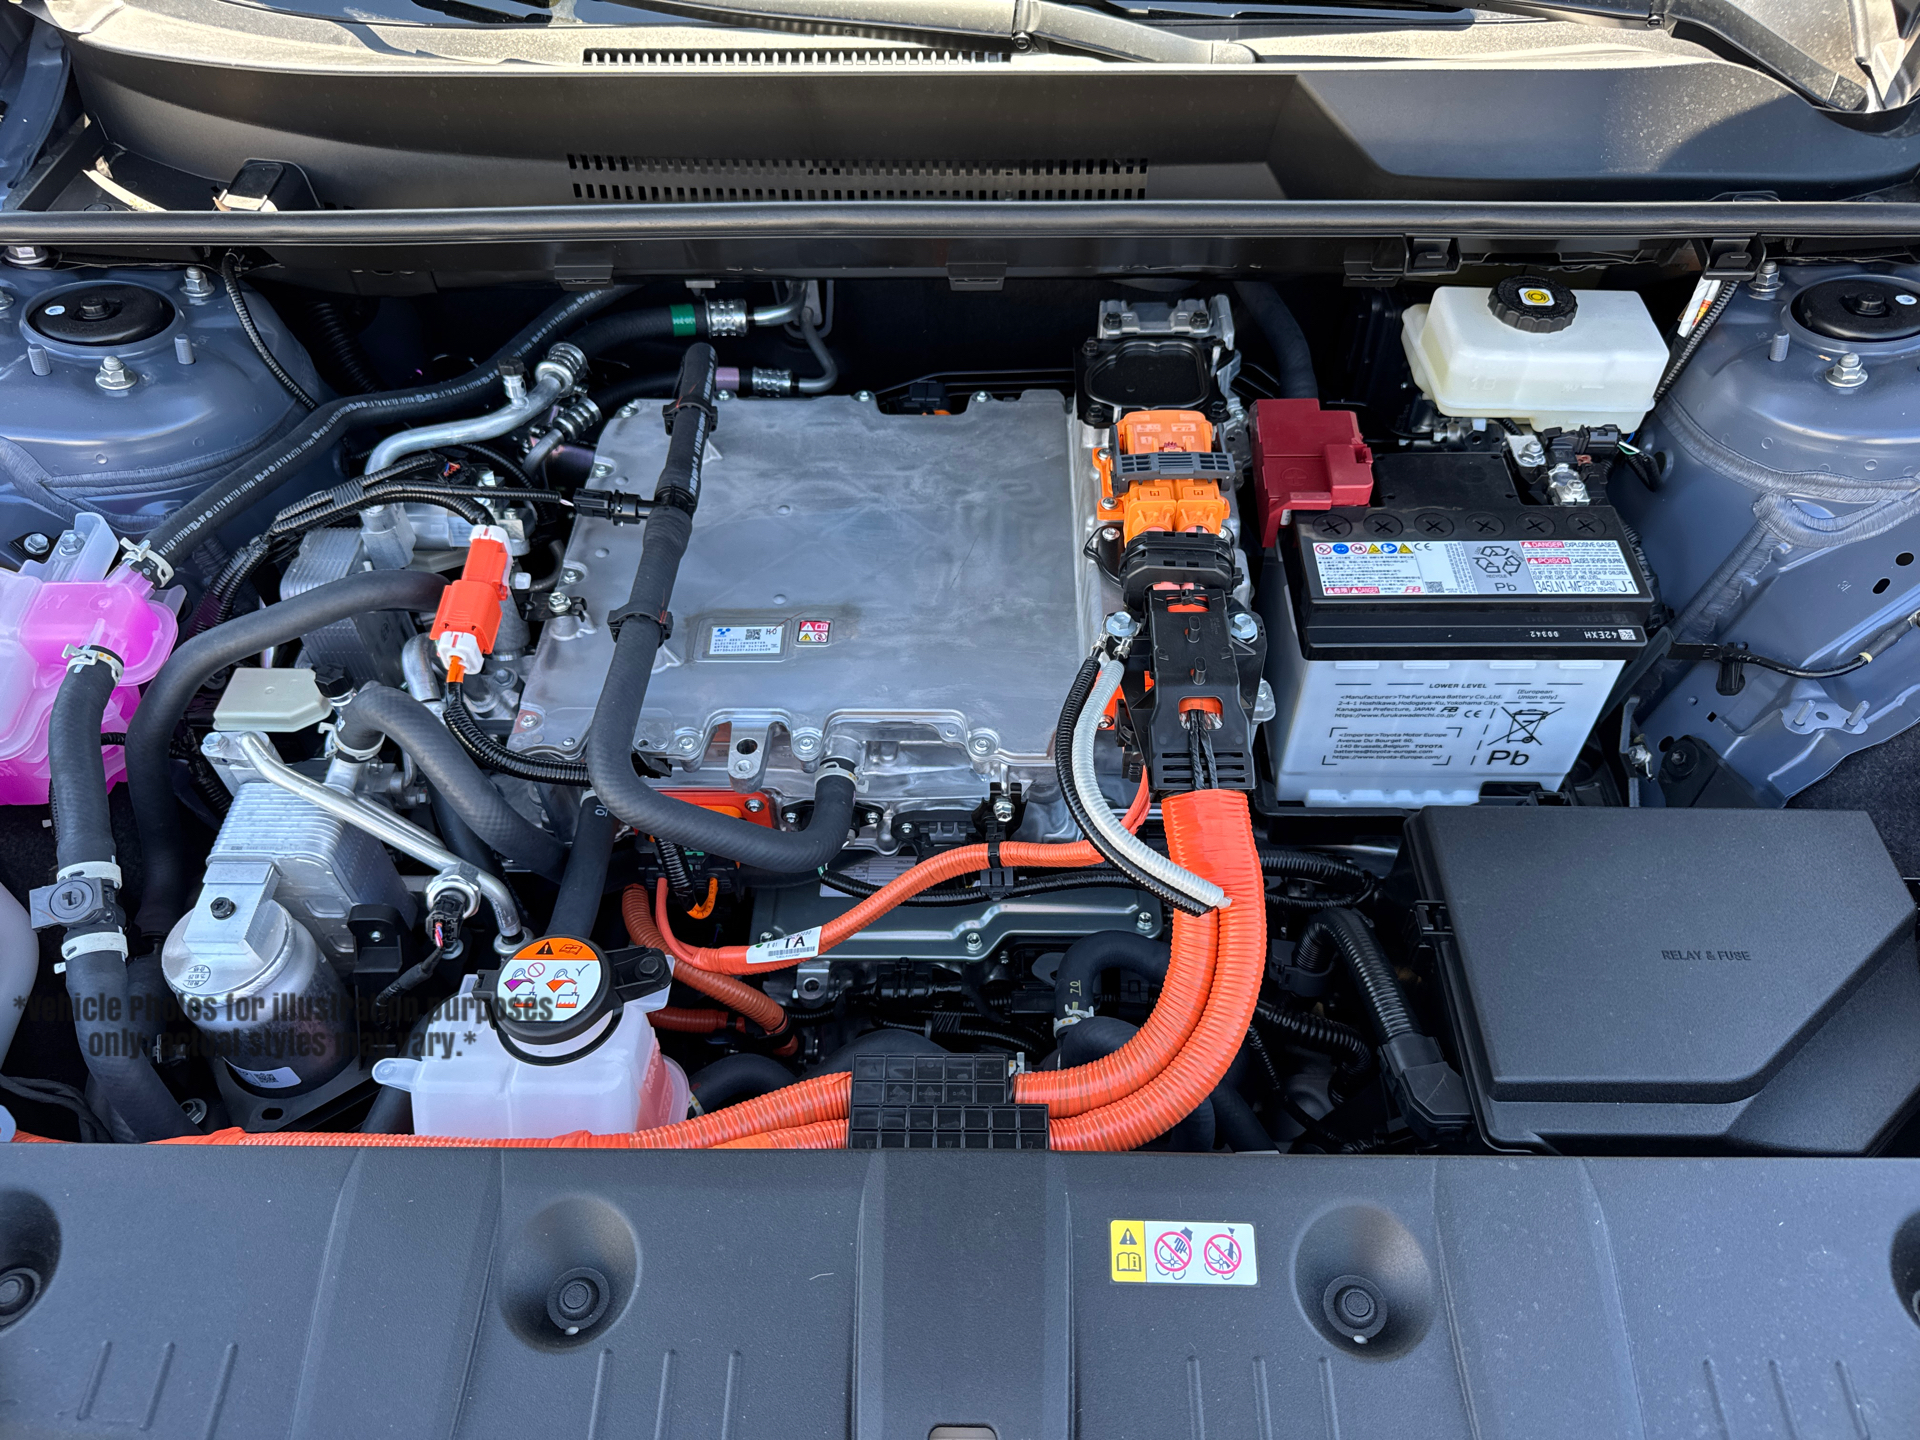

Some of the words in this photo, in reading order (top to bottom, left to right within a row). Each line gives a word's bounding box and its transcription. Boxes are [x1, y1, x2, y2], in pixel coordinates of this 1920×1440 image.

[1494, 582, 1517, 592] Pb
[1535, 581, 1583, 593] 345LN1-MF
[1584, 631, 1618, 639] 42EXH
[1486, 749, 1530, 766] Pb
[785, 936, 806, 949] TA
[1661, 949, 1703, 961] RELAY
[1706, 950, 1716, 961] &
[1716, 950, 1752, 961] FUSE
